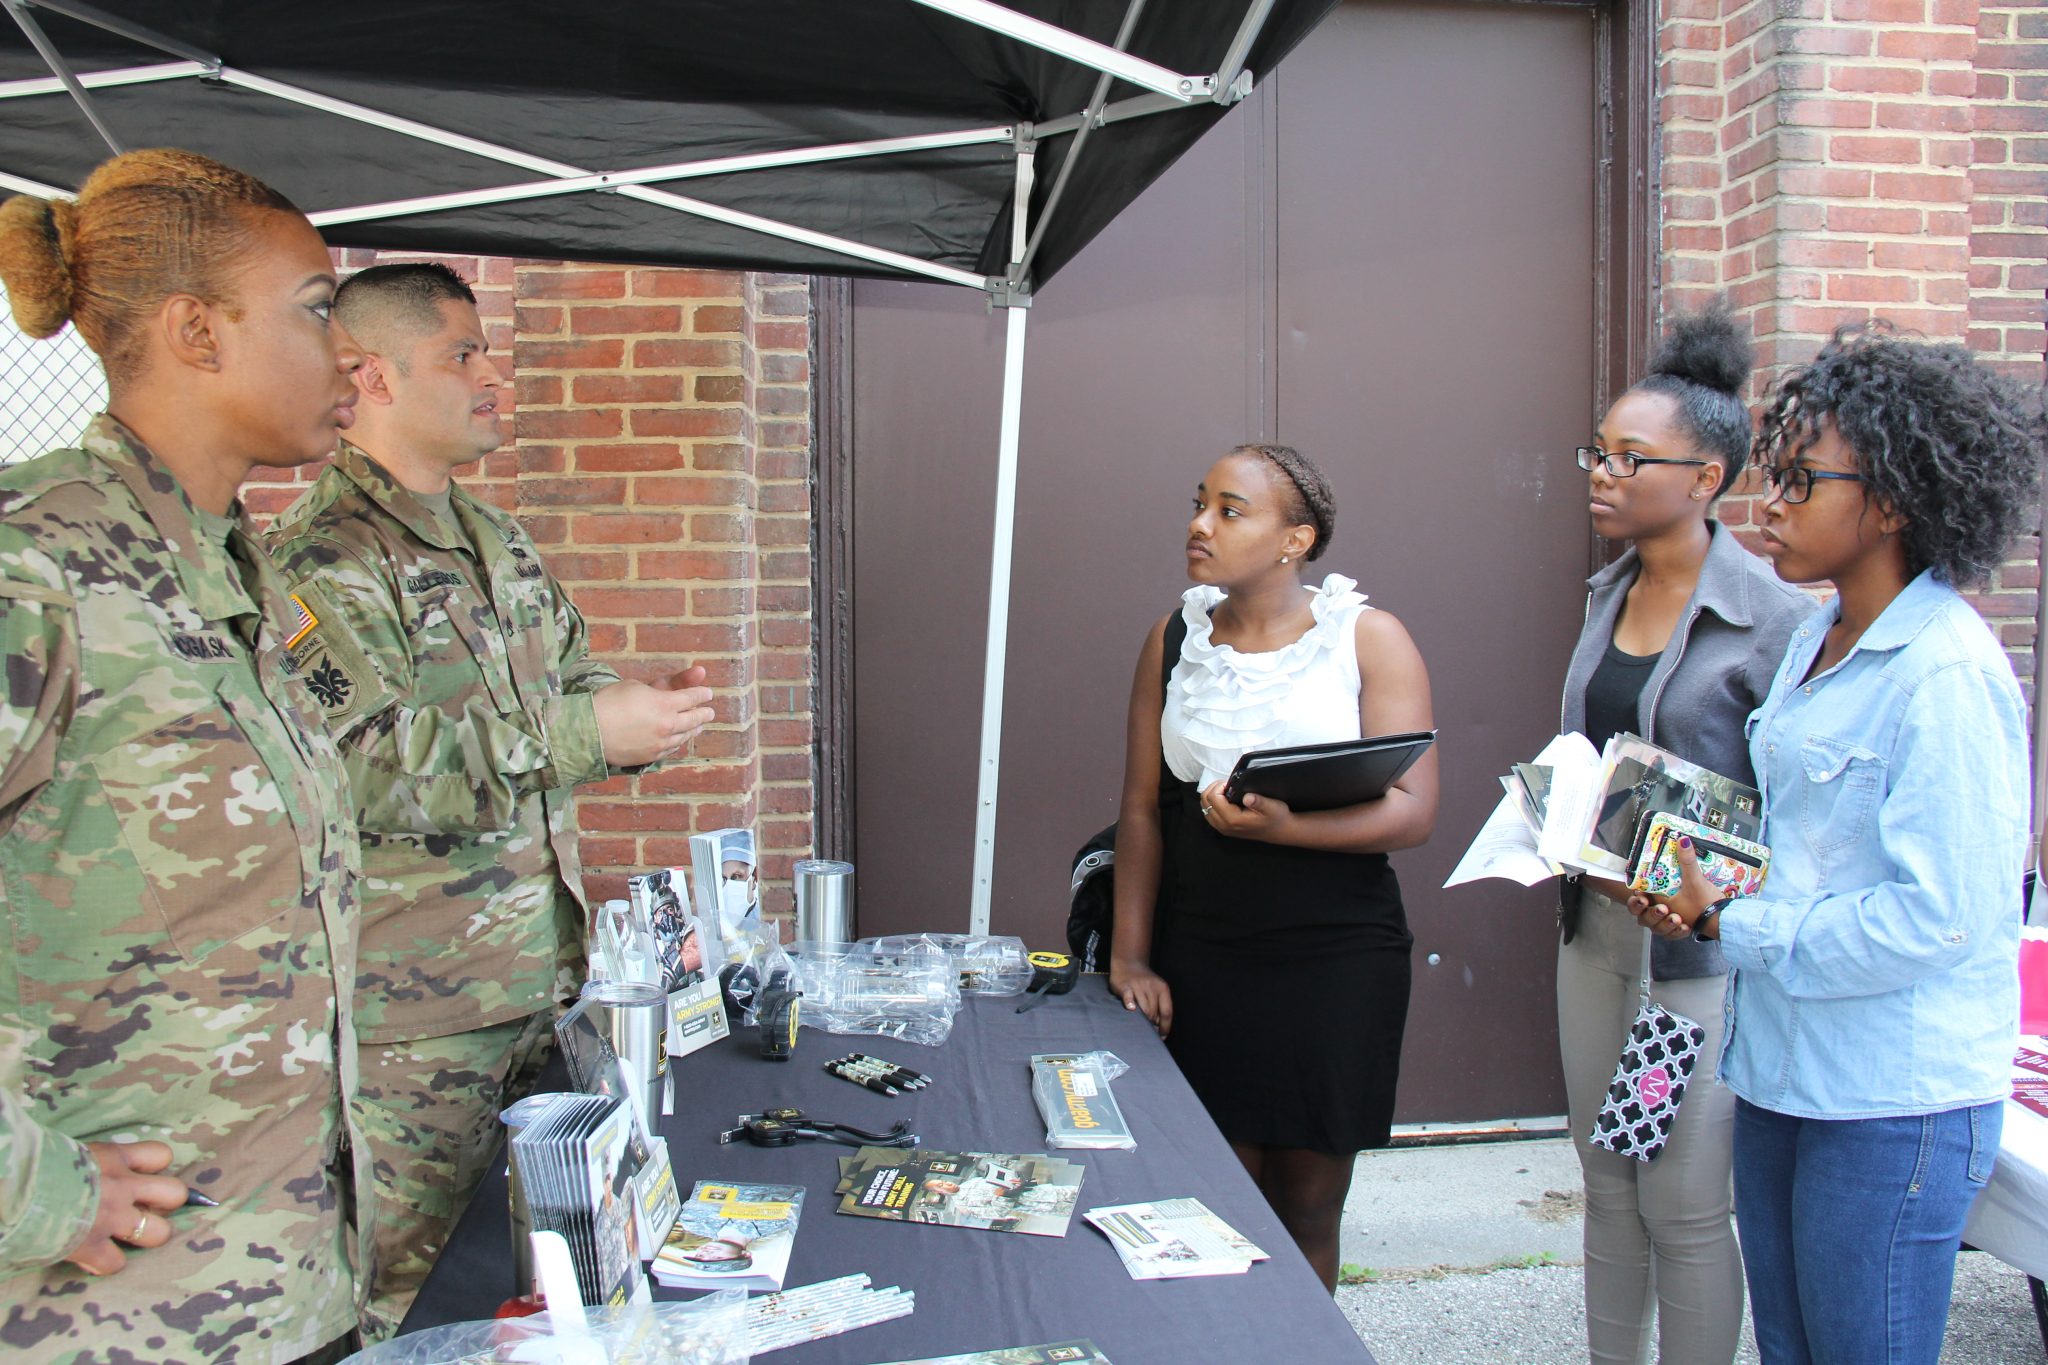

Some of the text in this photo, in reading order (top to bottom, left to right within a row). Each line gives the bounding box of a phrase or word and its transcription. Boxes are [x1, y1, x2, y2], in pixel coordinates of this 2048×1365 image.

[674, 991, 701, 1010] ARE YOU
[676, 1006, 695, 1021] ARMY
[1643, 1075, 1666, 1099] M
[1057, 1069, 1101, 1128] goarmycom
[861, 1188, 877, 1205] YOUR
[872, 1189, 889, 1206] YOUR
[884, 1190, 899, 1208] ARMY
[894, 1182, 915, 1208] TRAINING
